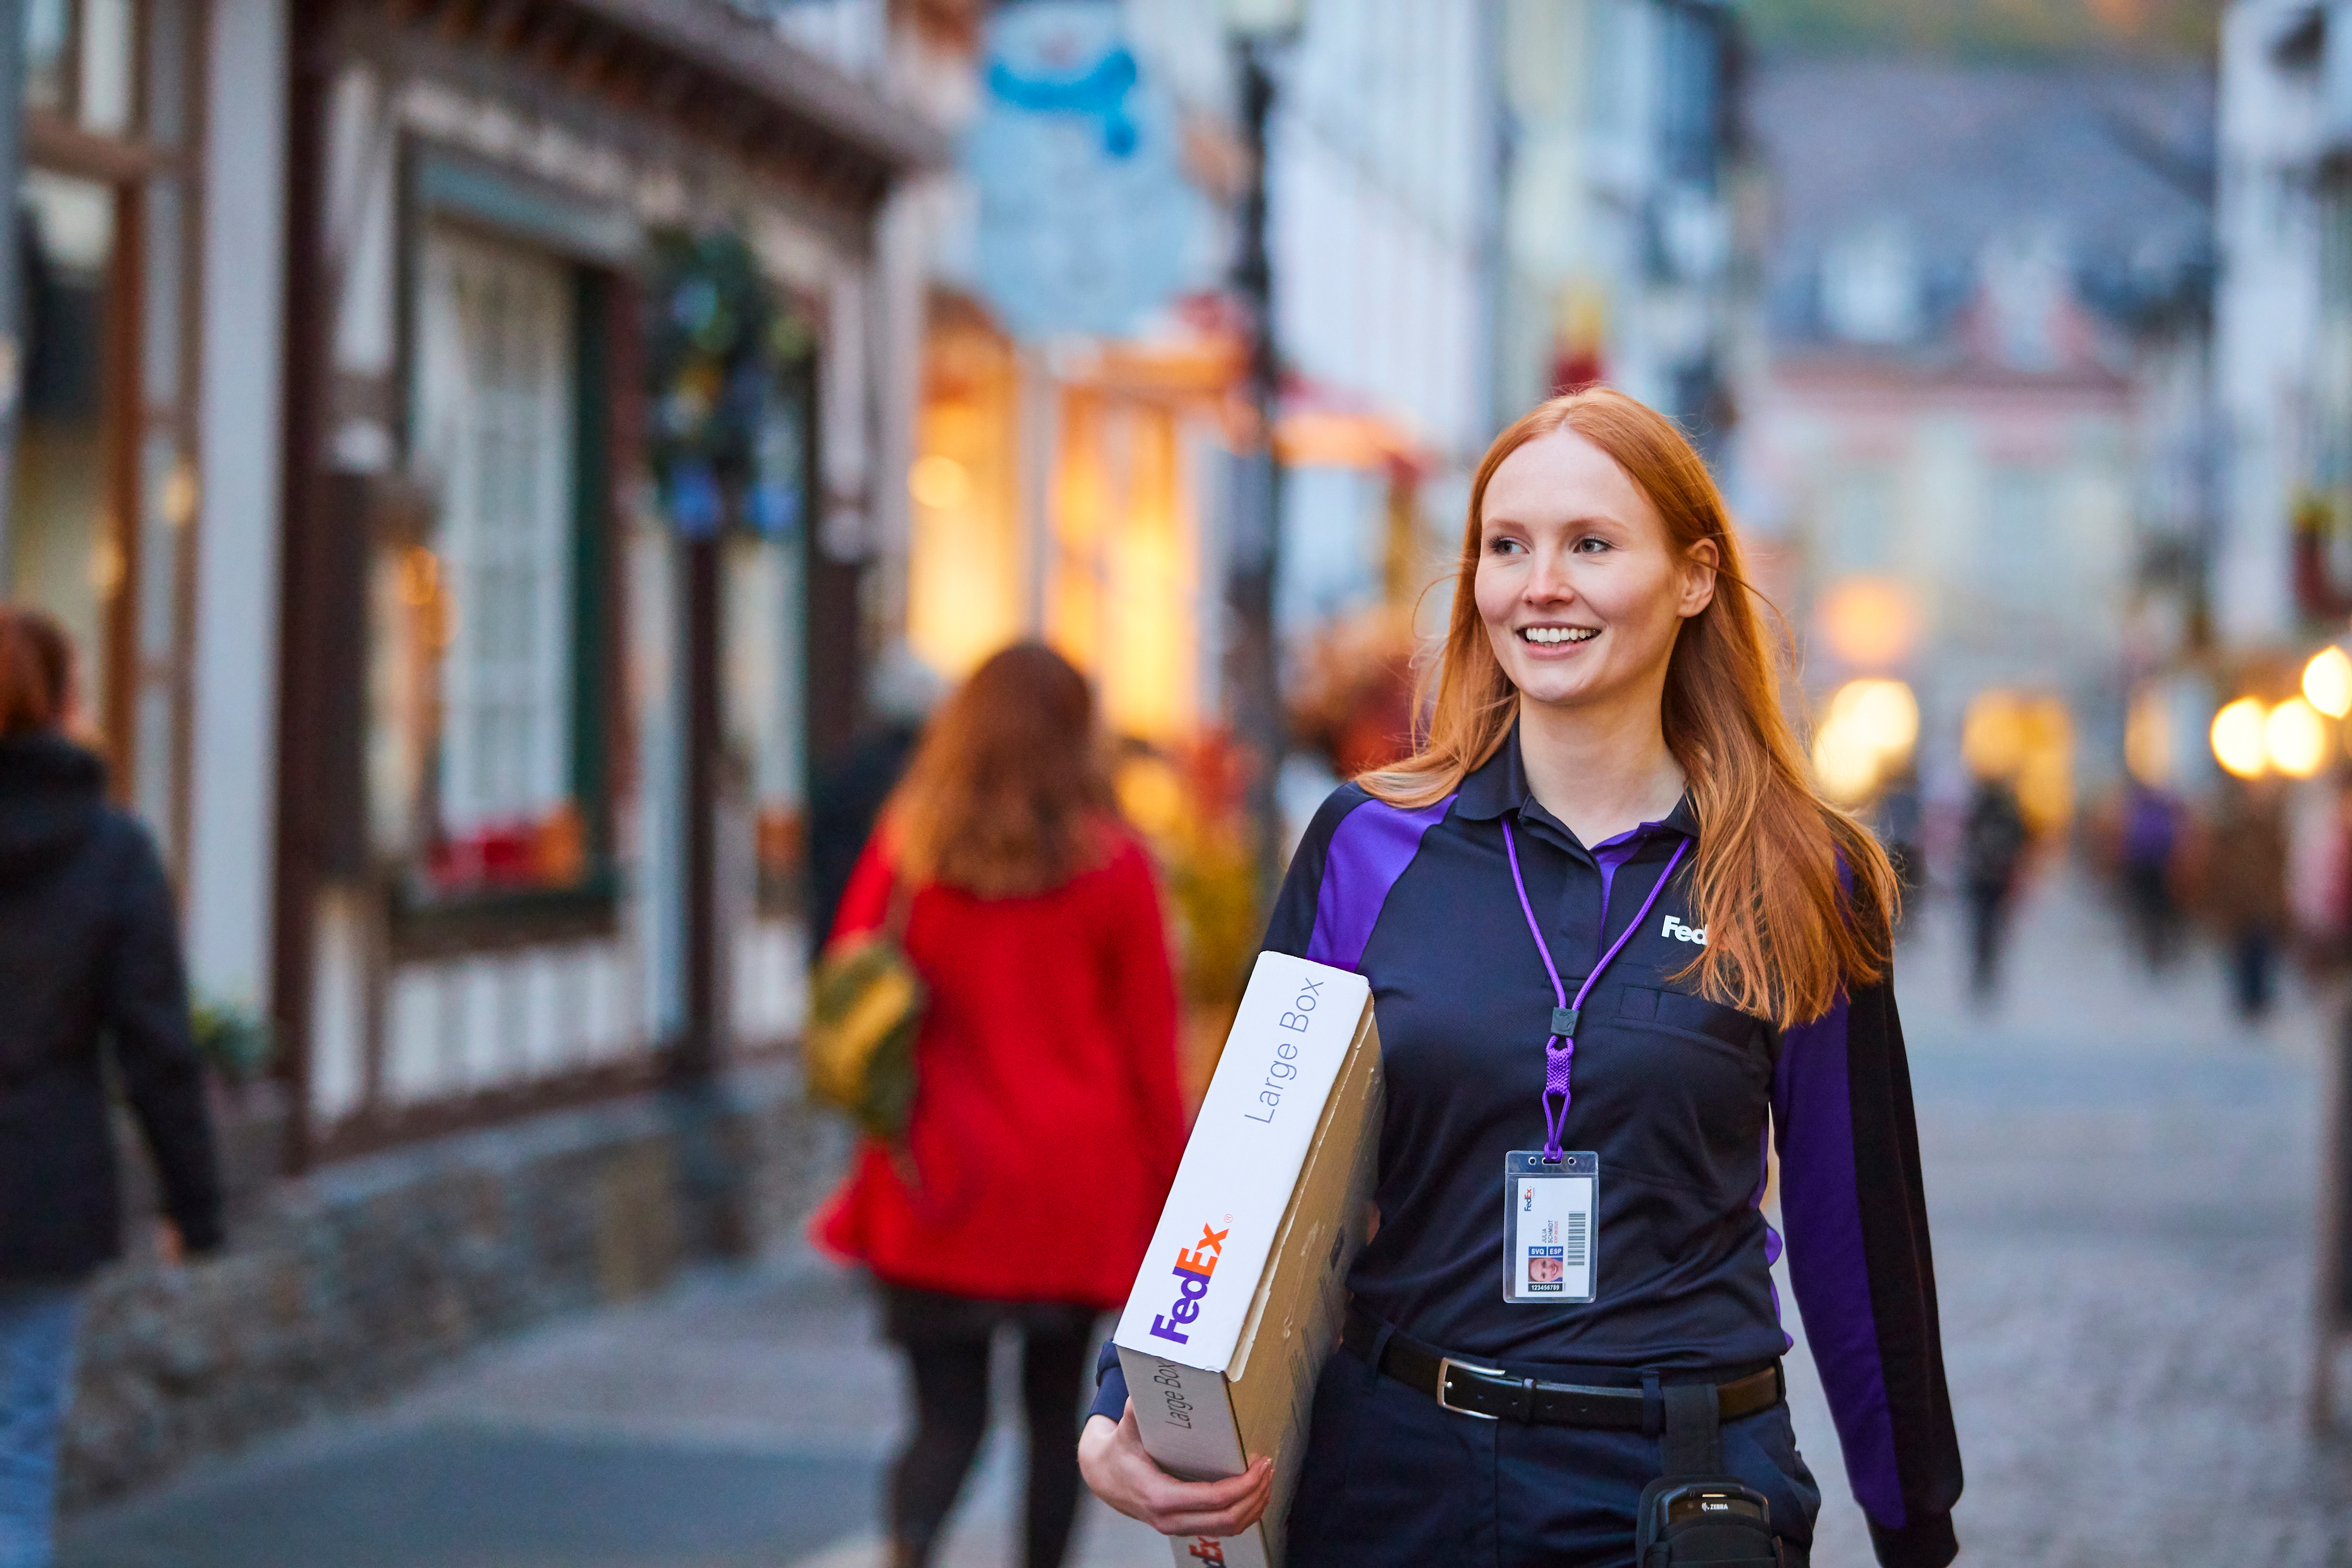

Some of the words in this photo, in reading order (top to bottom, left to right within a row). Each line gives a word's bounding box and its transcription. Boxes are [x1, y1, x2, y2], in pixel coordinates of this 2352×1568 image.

[1662, 915, 1708, 945] Fed
[1244, 1044, 1297, 1123] Large
[1279, 977, 1324, 1032] Box
[1154, 1360, 1181, 1389] Box
[1165, 1391, 1193, 1429] Large
